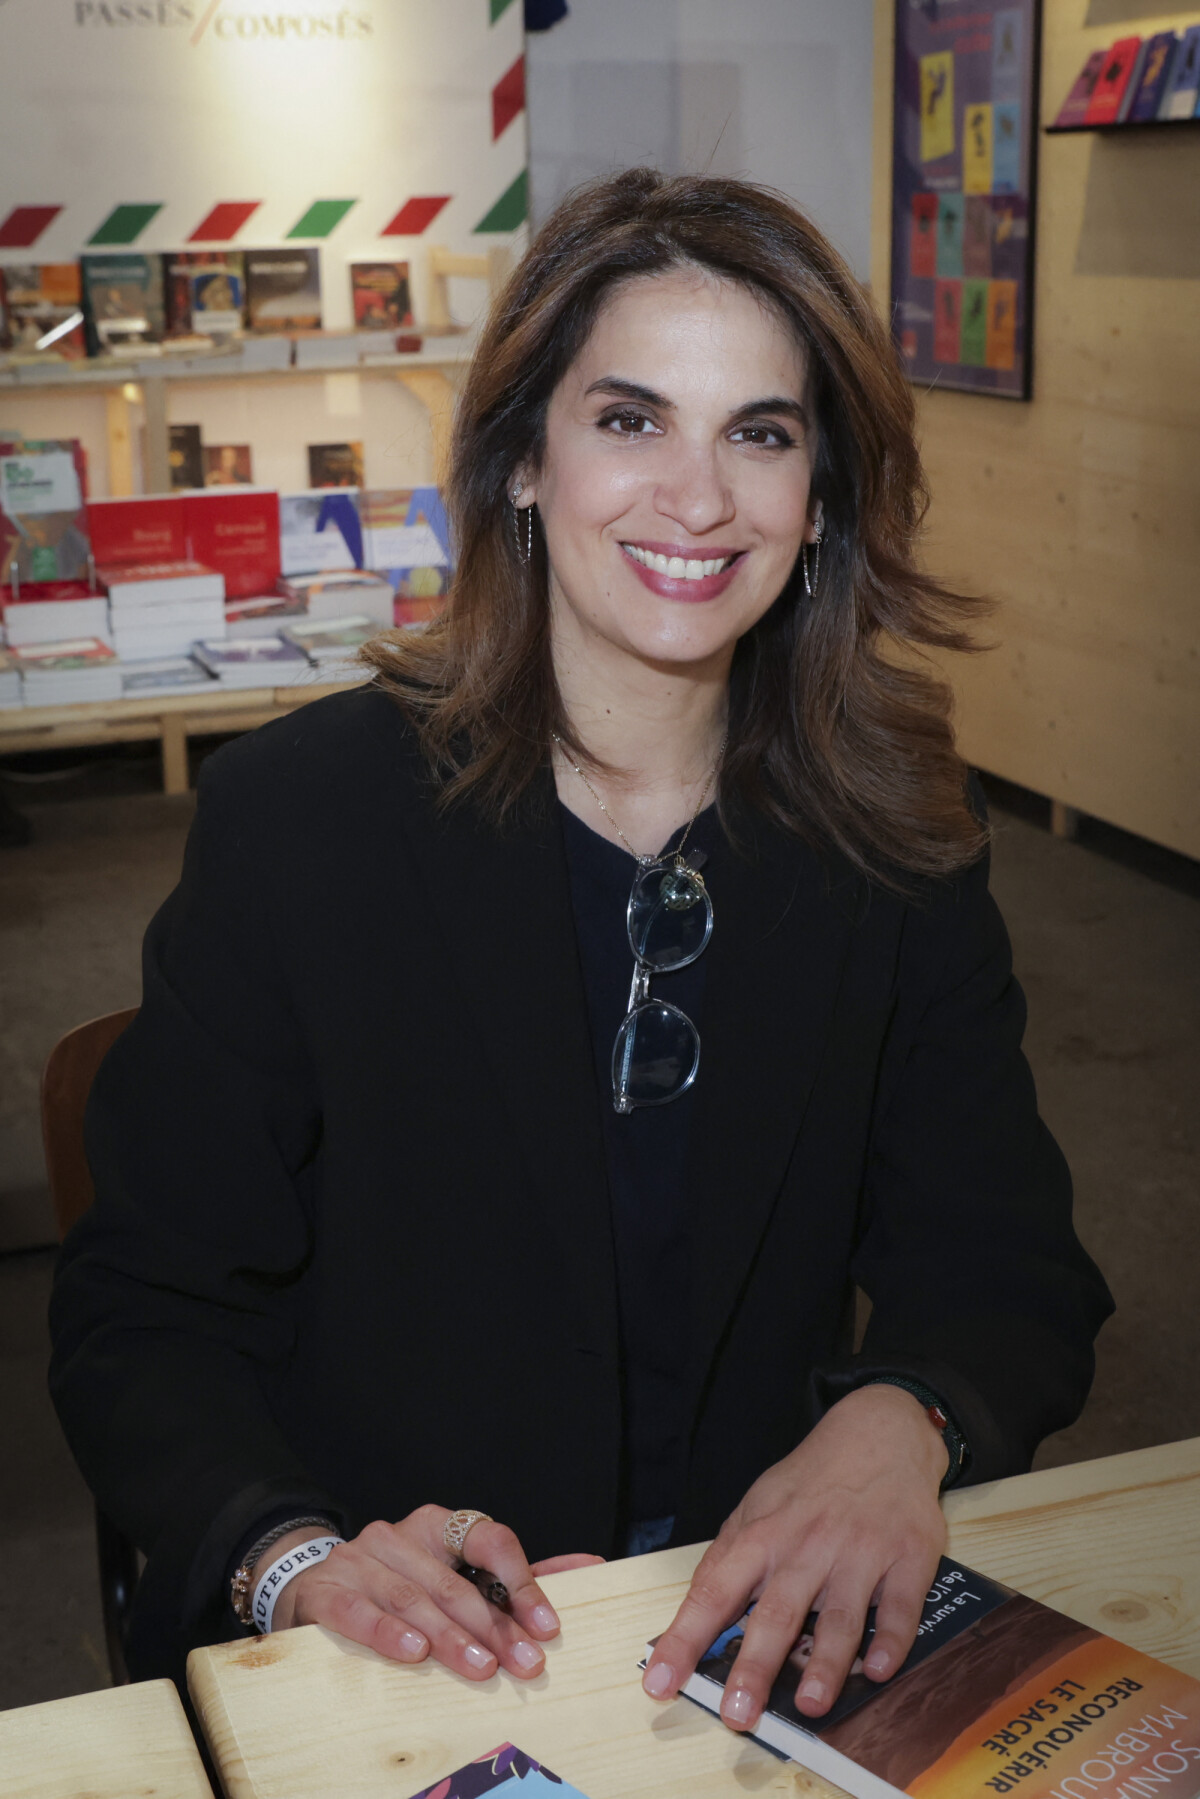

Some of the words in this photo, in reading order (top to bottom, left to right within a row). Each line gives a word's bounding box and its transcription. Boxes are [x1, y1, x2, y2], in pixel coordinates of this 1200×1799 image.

[256, 1545, 322, 1634] AUTEURS
[925, 1582, 953, 1603] l'O
[941, 1571, 967, 1583] de
[951, 1591, 982, 1605] La
[1049, 1679, 1087, 1702] LE
[980, 1698, 1060, 1758] SACRÉ
[984, 1676, 1145, 1794] RECONQUÉRIR
[1049, 1704, 1189, 1799] MABROU
